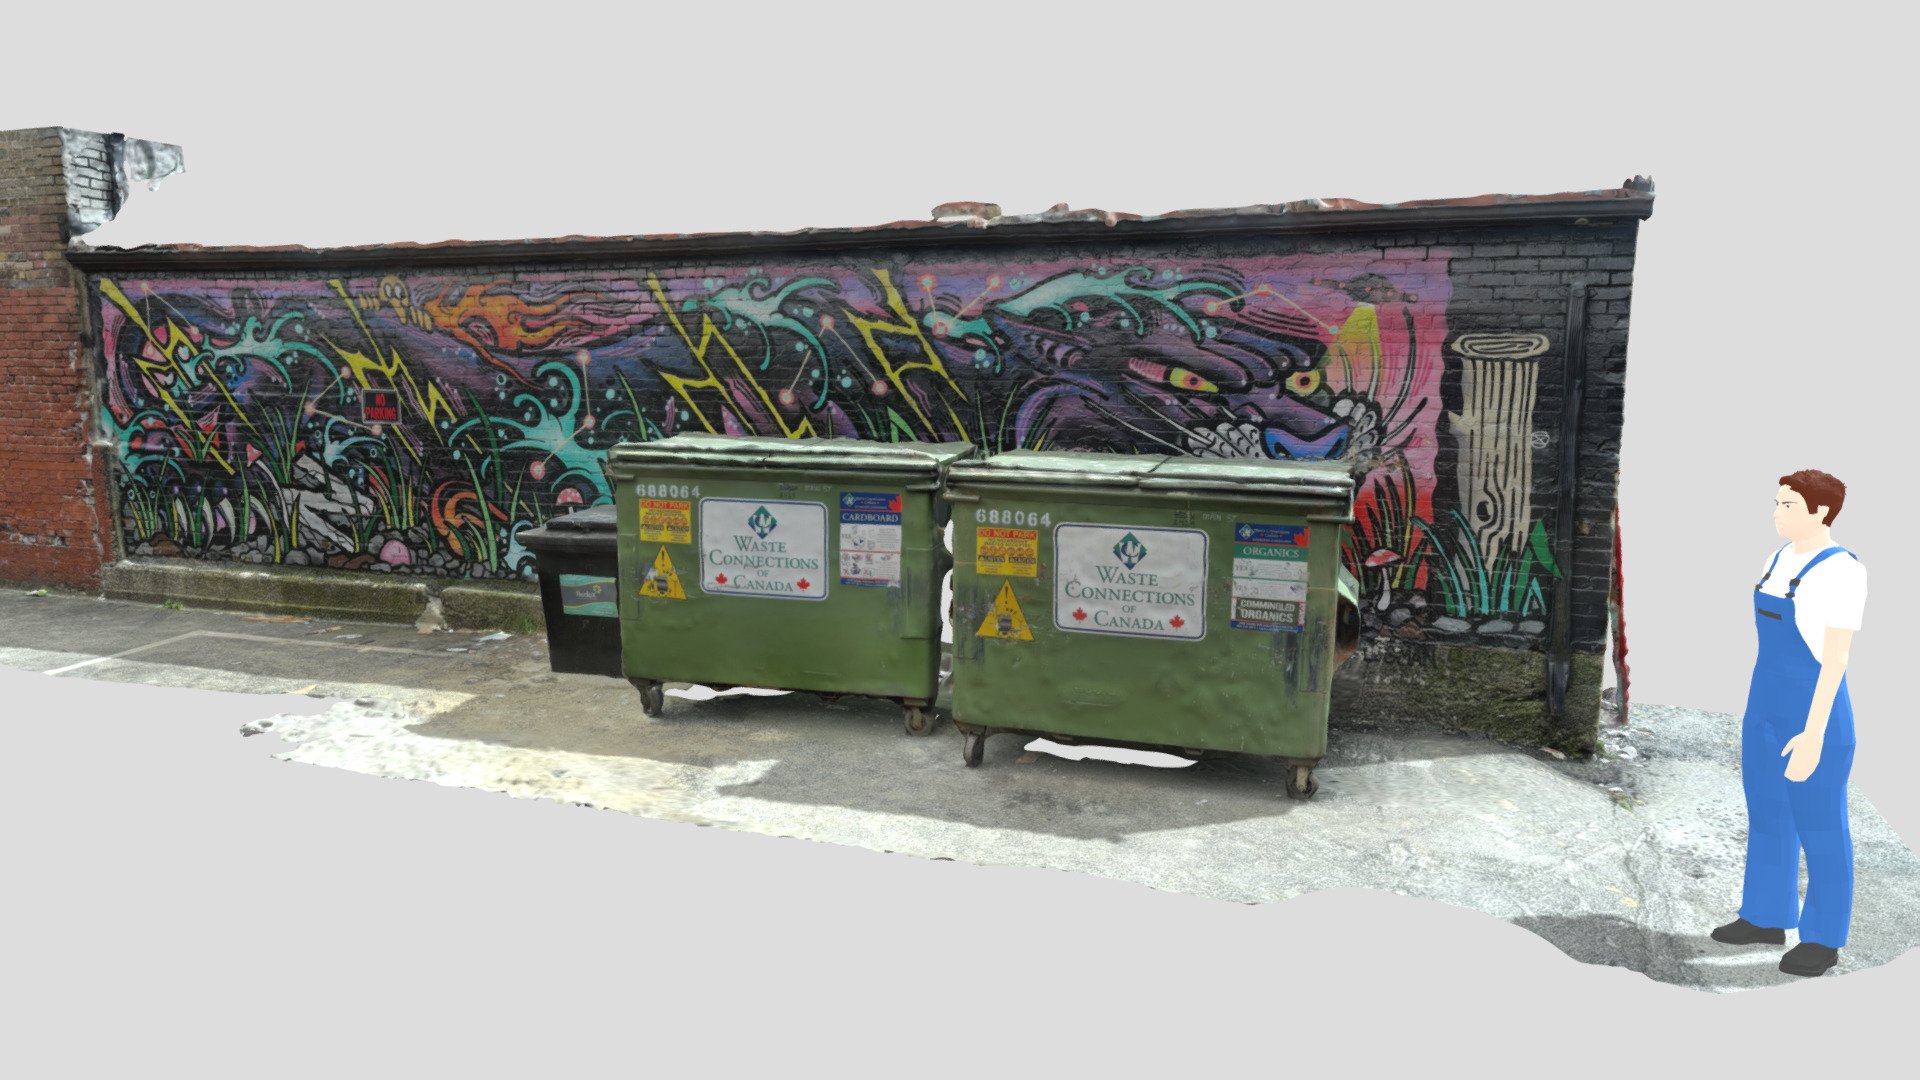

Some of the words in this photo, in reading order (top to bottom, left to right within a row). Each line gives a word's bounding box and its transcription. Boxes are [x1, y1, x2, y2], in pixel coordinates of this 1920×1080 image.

[375, 393, 386, 407] NO
[365, 406, 397, 420] PARKING
[636, 484, 700, 498] 688064
[842, 512, 899, 522] CARDBOARD
[976, 509, 1051, 527] 688064
[993, 529, 1010, 539] NOT
[1012, 530, 1037, 541] PARK
[733, 535, 787, 552] WASTE
[1242, 546, 1300, 558] ORGANICS
[709, 549, 819, 570] CONNECTIONS
[1096, 565, 1158, 587] WASTE
[733, 575, 793, 592] CANADA
[1064, 580, 1195, 606] CONNECTIONS
[1122, 605, 1137, 613] OF
[1240, 599, 1296, 612] COMMINGLED
[1094, 610, 1164, 630] CANADA
[1240, 608, 1294, 623] ORGANICS
